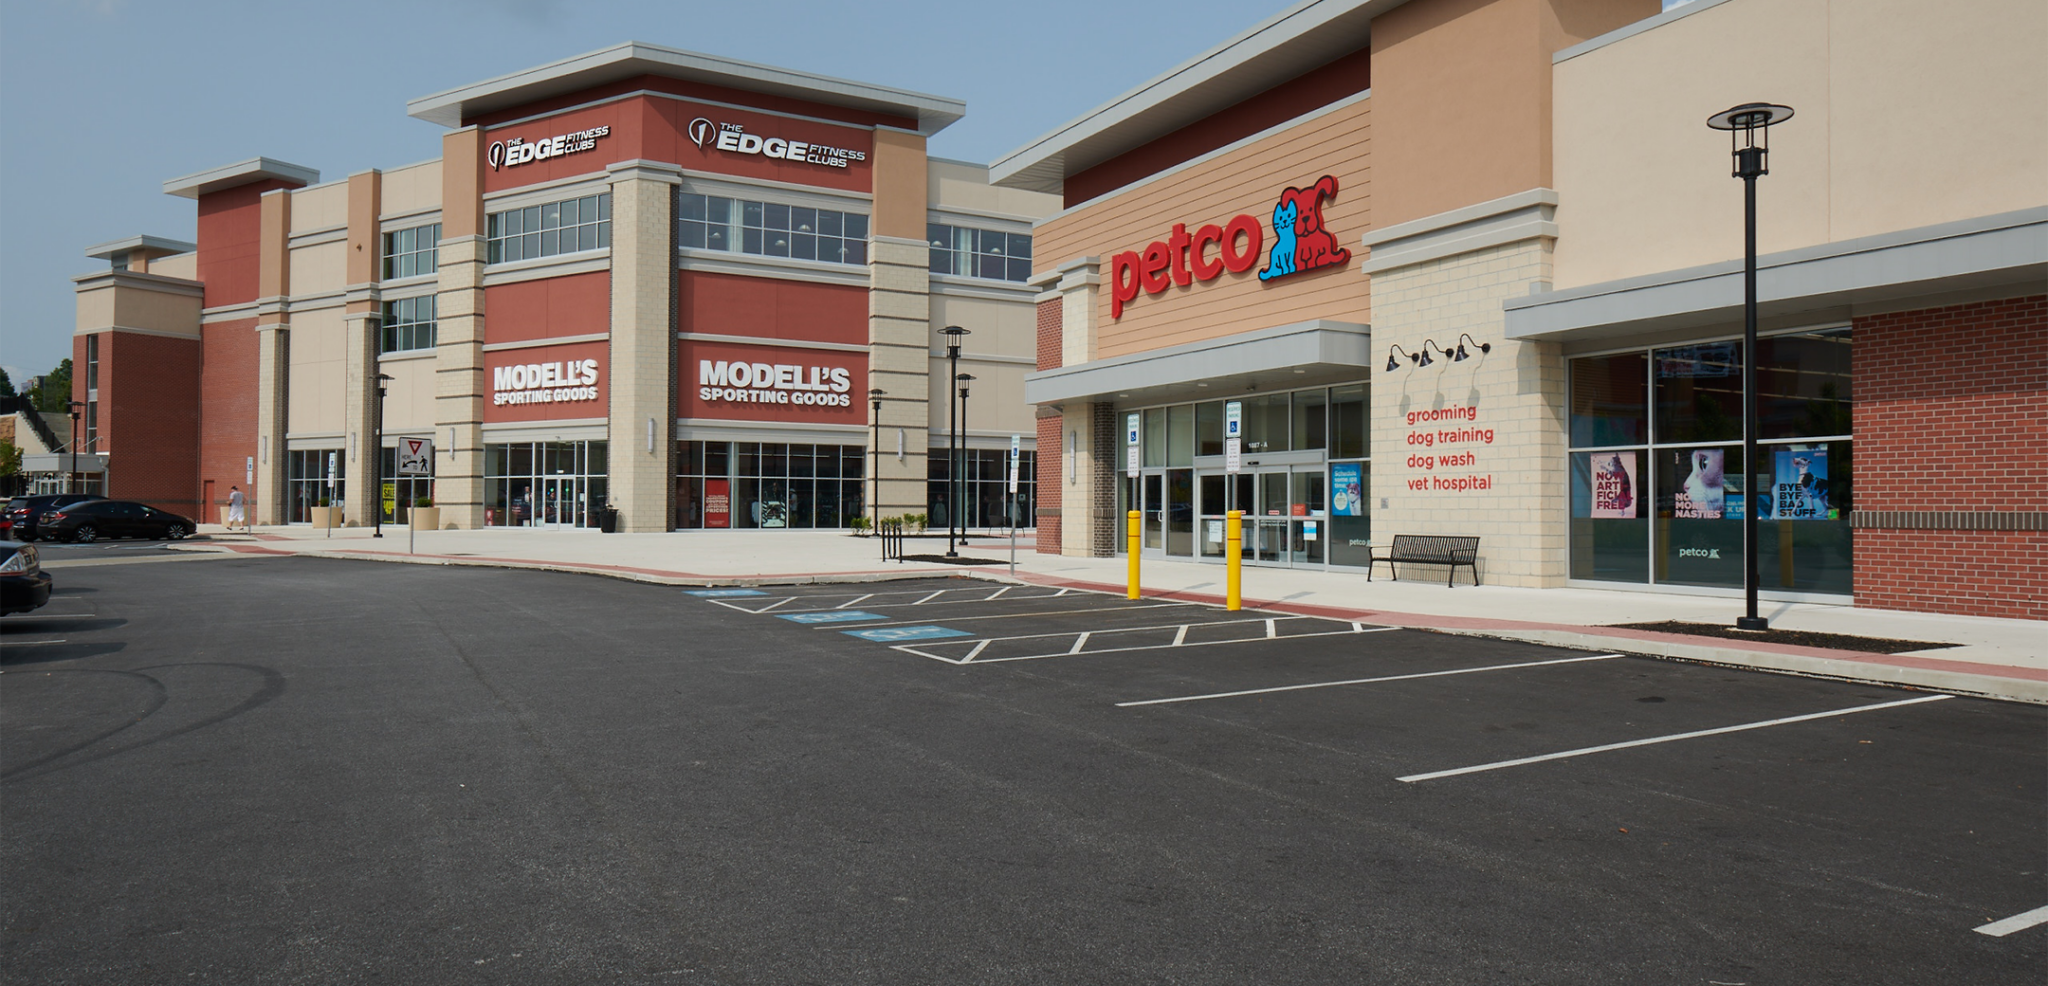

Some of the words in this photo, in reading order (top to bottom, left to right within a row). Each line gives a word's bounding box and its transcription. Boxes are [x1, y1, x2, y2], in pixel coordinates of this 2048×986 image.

[566, 126, 609, 143] FITNESS
[720, 122, 743, 132] THE
[507, 137, 524, 147] THE
[564, 139, 596, 154] CLUBS
[716, 130, 808, 161] EDGE
[505, 135, 566, 167] EDGE
[809, 144, 866, 162] FITNESS
[807, 153, 848, 168] CLUBS
[1112, 213, 1264, 319] petco
[494, 359, 600, 391] MODELL'S
[699, 359, 851, 393] MODELL'S
[494, 389, 553, 406] SPORTING
[553, 386, 599, 402] GOODS
[699, 387, 789, 404] SPORTING
[791, 392, 851, 407] GOODS
[1407, 404, 1477, 425] grooming
[1407, 430, 1434, 447] dog
[1438, 426, 1495, 444] training
[1407, 453, 1434, 470] dog
[1438, 451, 1475, 467] wash
[1407, 476, 1429, 491] vet
[1433, 474, 1492, 493] hospital
[1596, 471, 1625, 481] NOW
[1780, 483, 1803, 491] BYE
[1675, 493, 1691, 502] NO
[1780, 492, 1804, 500] BYE
[1597, 500, 1626, 510] FREE
[1675, 501, 1708, 510] MORE
[1780, 500, 1804, 508] BAD
[1675, 510, 1721, 519] NASTIES
[1780, 508, 1816, 517] STUFF
[1680, 547, 1708, 557] petco
